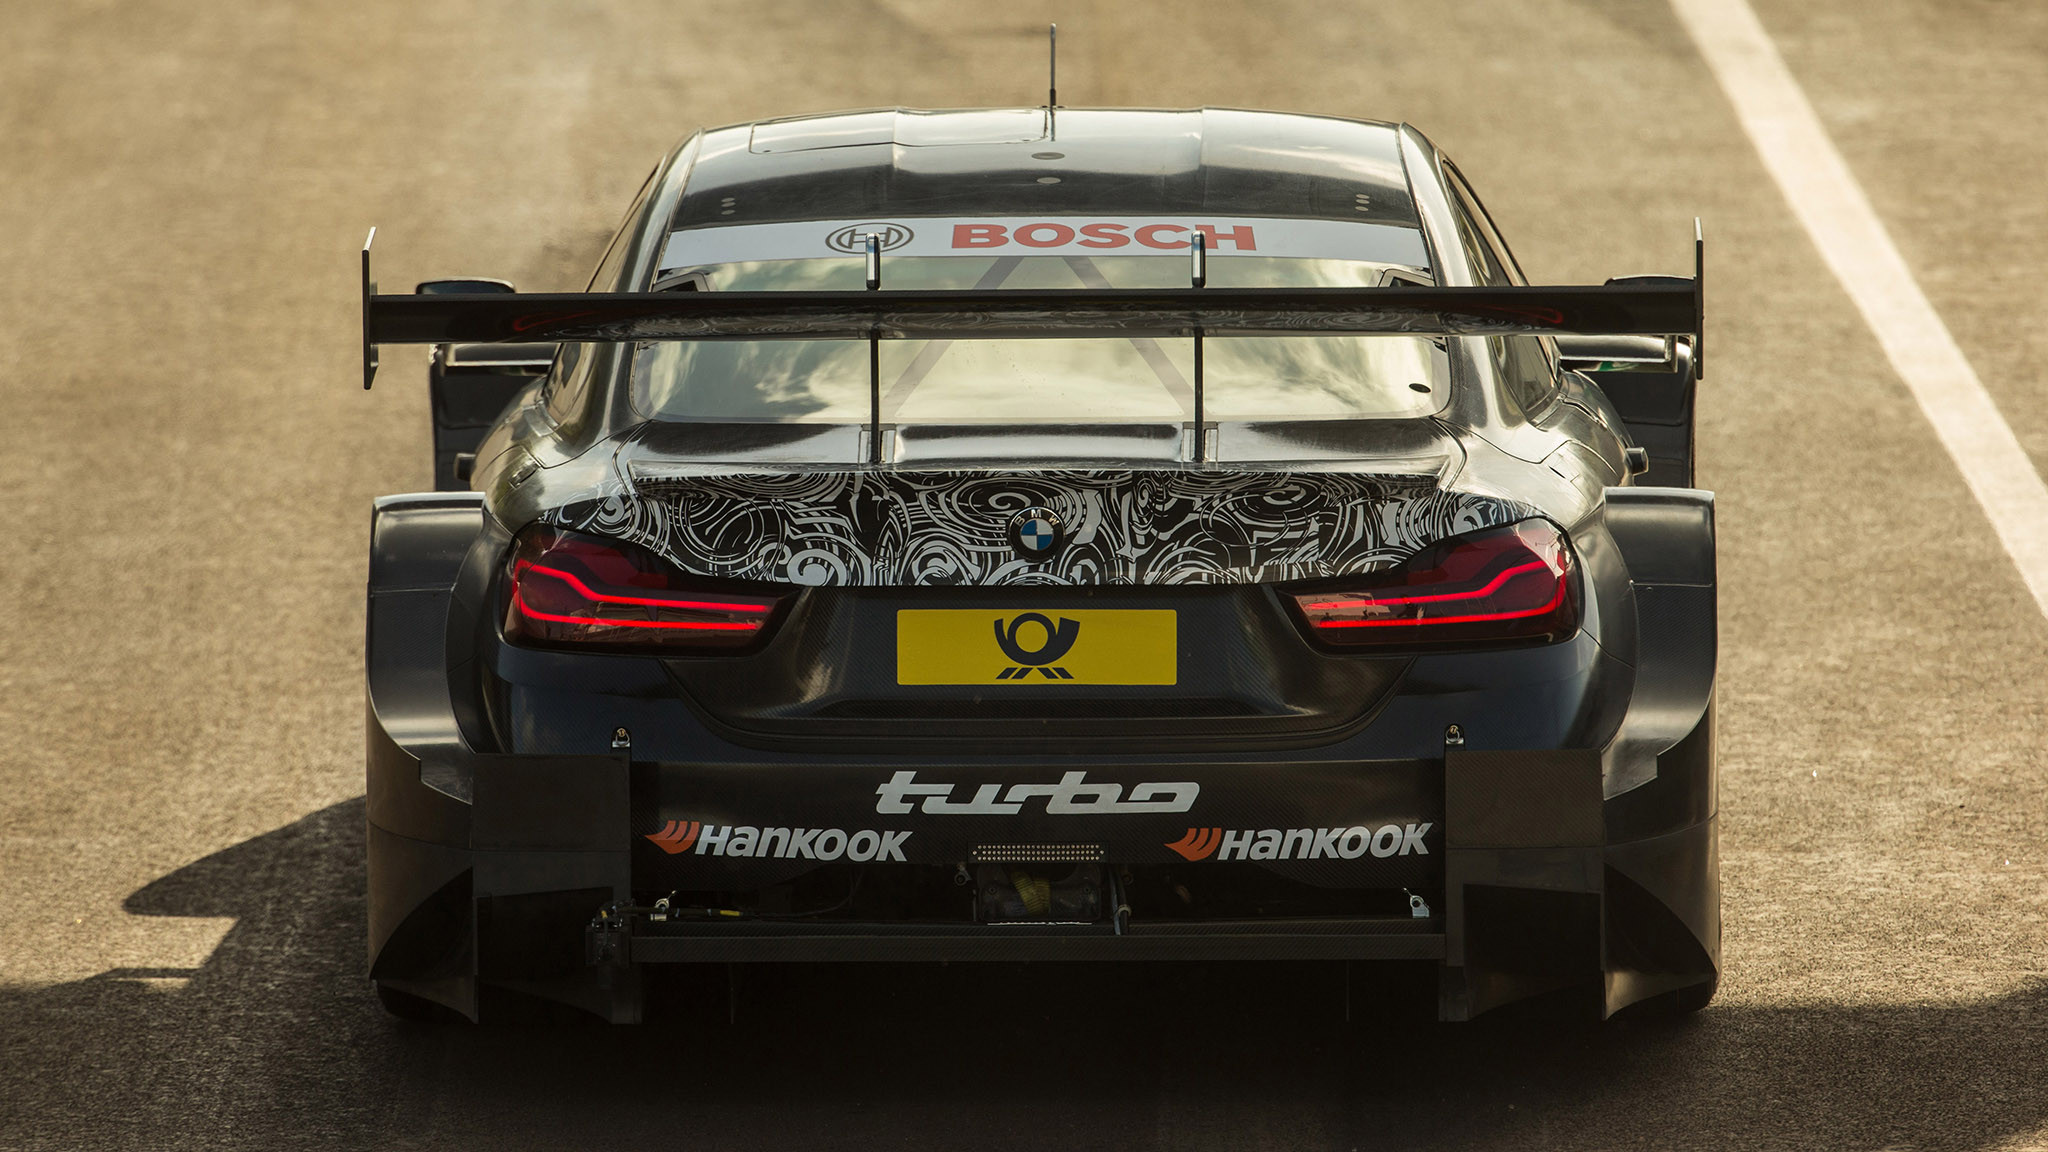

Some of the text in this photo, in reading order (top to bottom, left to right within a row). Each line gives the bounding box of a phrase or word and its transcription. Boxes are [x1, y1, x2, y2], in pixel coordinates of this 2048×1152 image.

[951, 223, 1256, 251] BOSCH
[1013, 508, 1060, 526] BMW
[875, 771, 1200, 815] turbo
